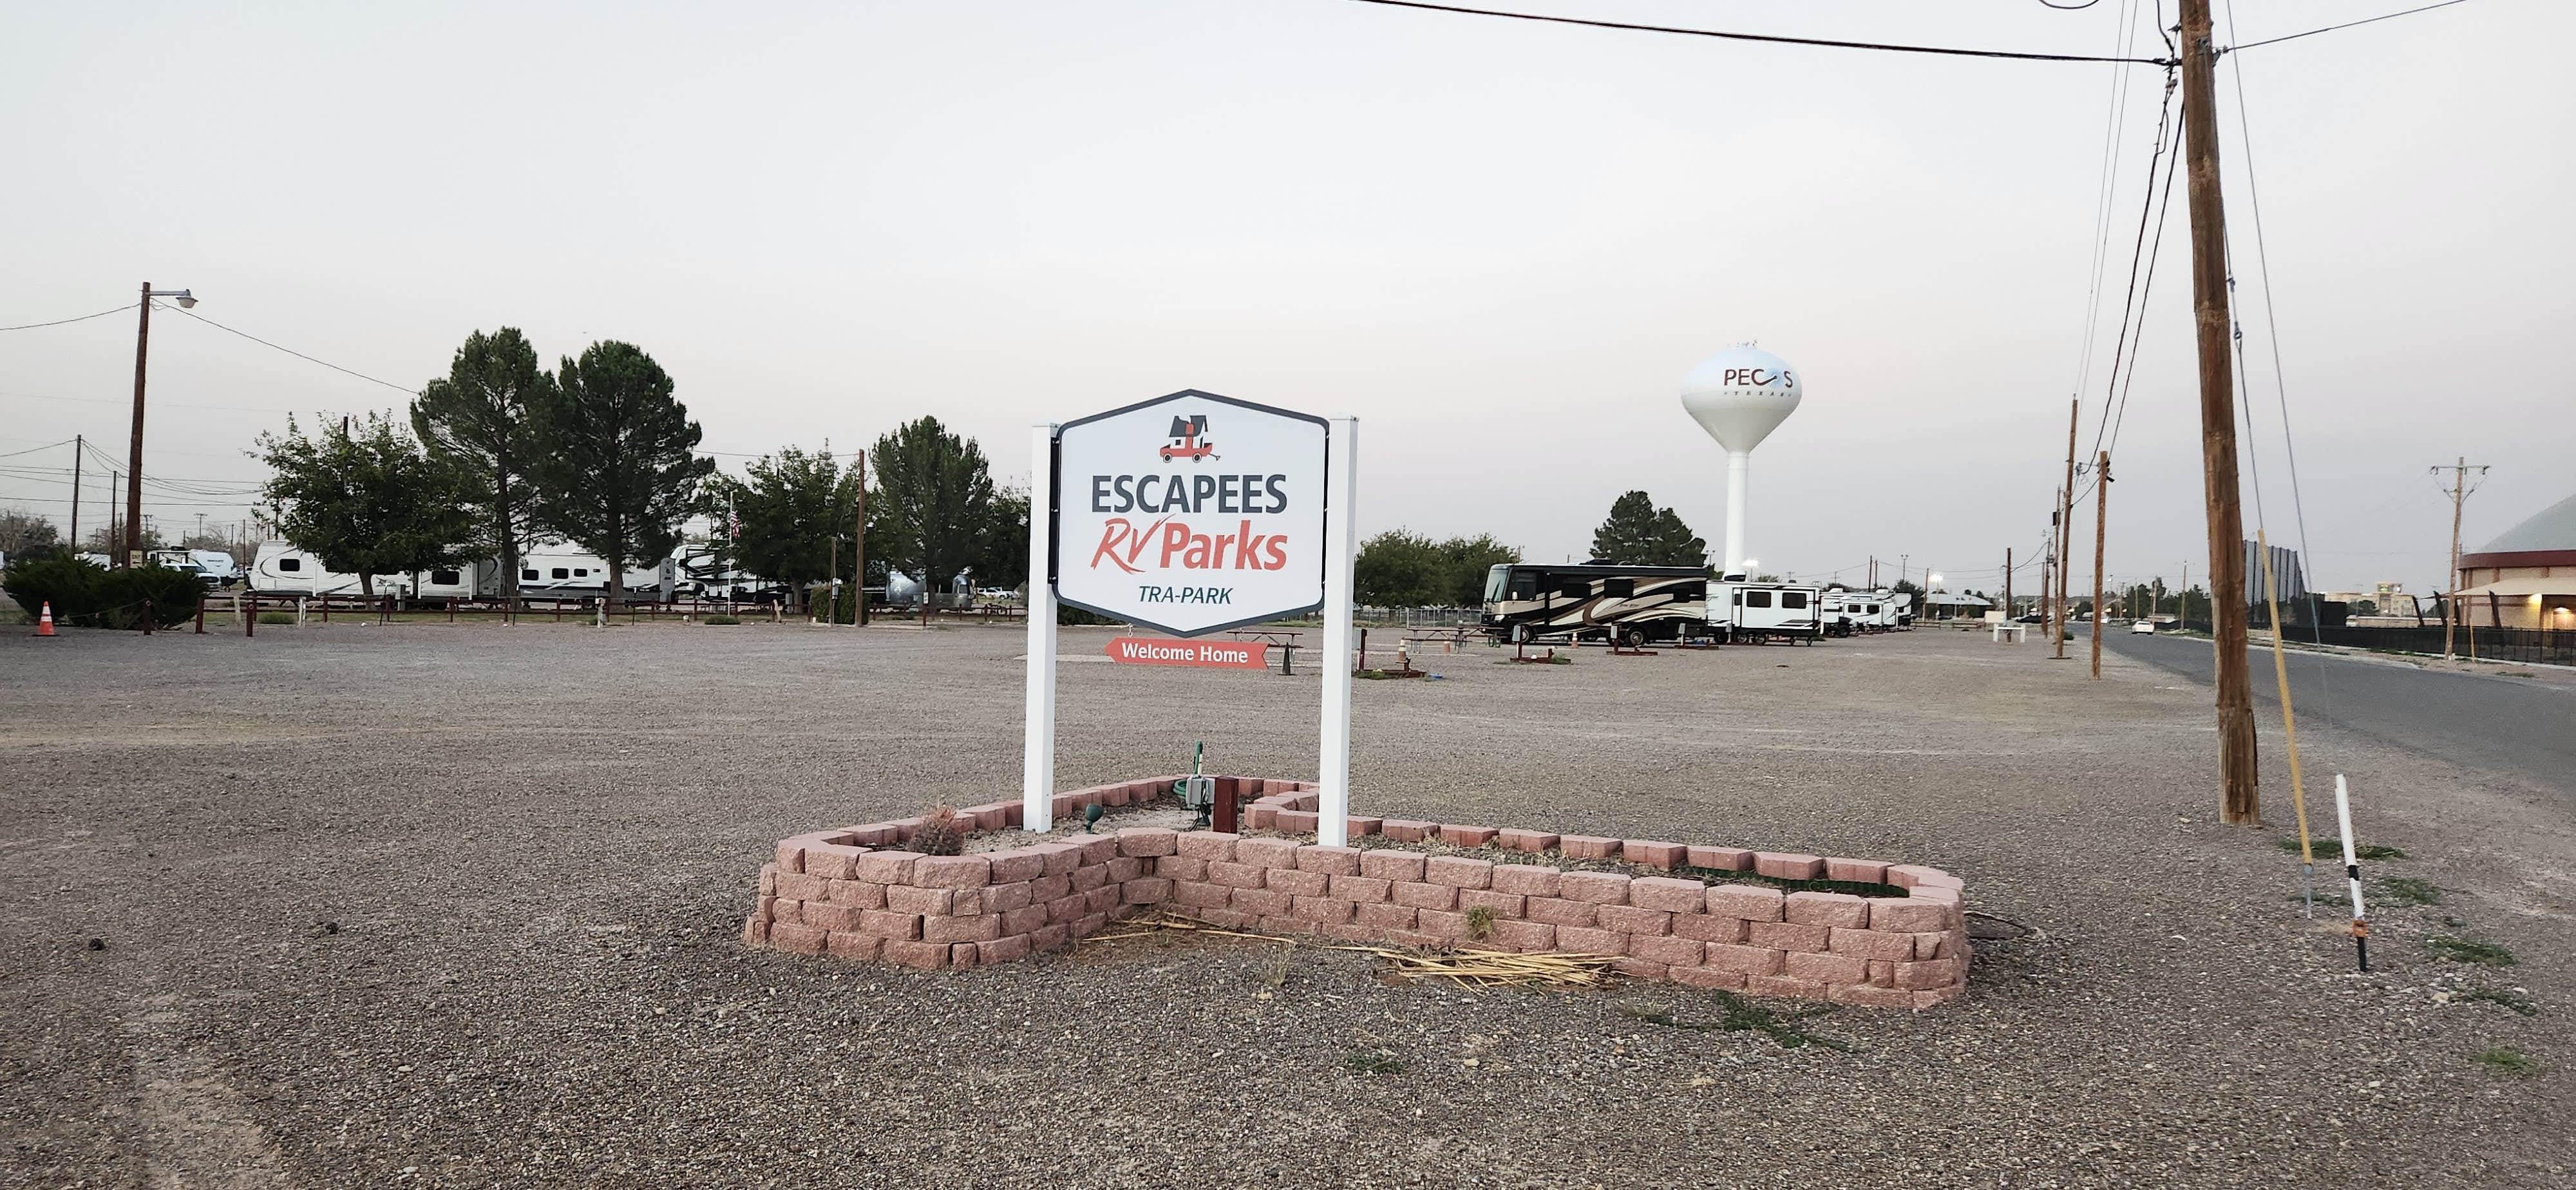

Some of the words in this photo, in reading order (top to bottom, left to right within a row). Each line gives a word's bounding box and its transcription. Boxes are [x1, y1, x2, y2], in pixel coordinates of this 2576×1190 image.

[1092, 475, 1287, 513] ESCAPEES
[1090, 514, 1176, 574] RV
[1159, 520, 1288, 571] Parks
[1139, 585, 1233, 605] TRA-PARK
[1122, 643, 1195, 661] Welcome
[1200, 646, 1248, 663] Home
